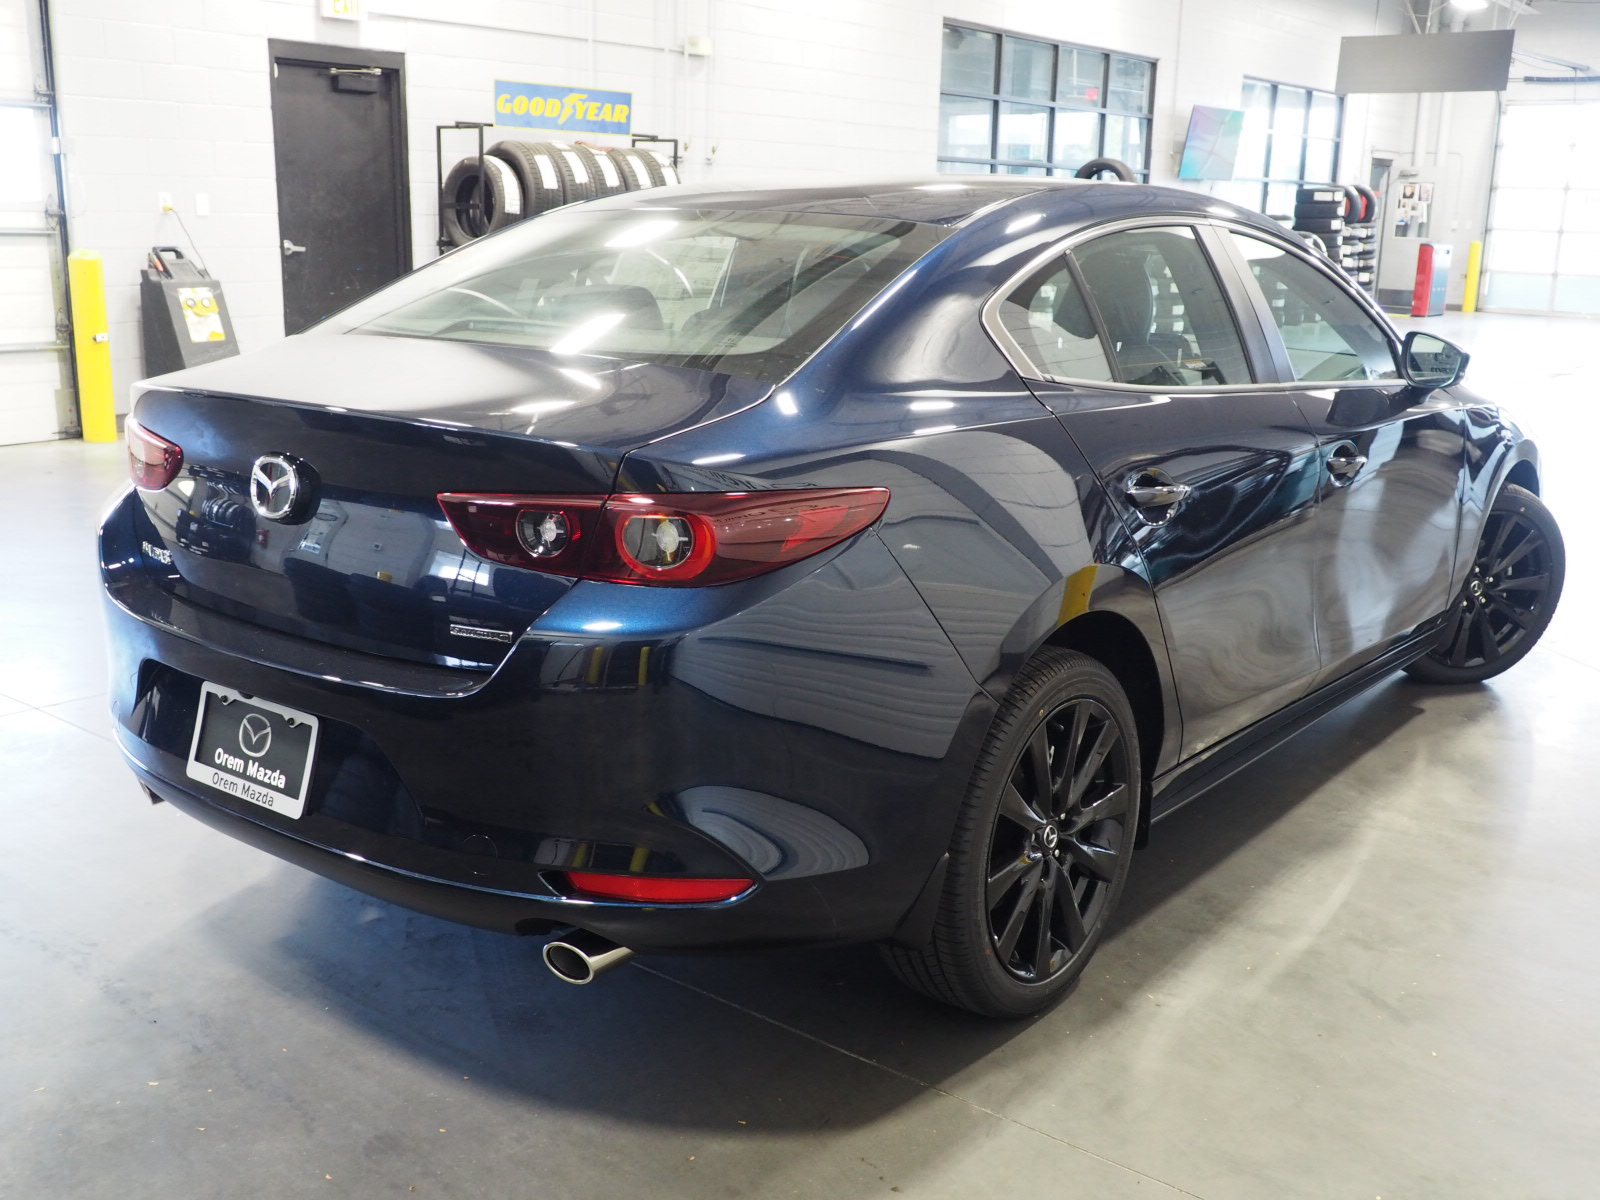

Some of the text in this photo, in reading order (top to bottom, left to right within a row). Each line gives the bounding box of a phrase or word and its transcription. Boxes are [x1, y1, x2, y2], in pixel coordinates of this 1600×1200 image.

[214, 747, 286, 789] Orem Mazda
[212, 772, 274, 807] Orem Mazda
